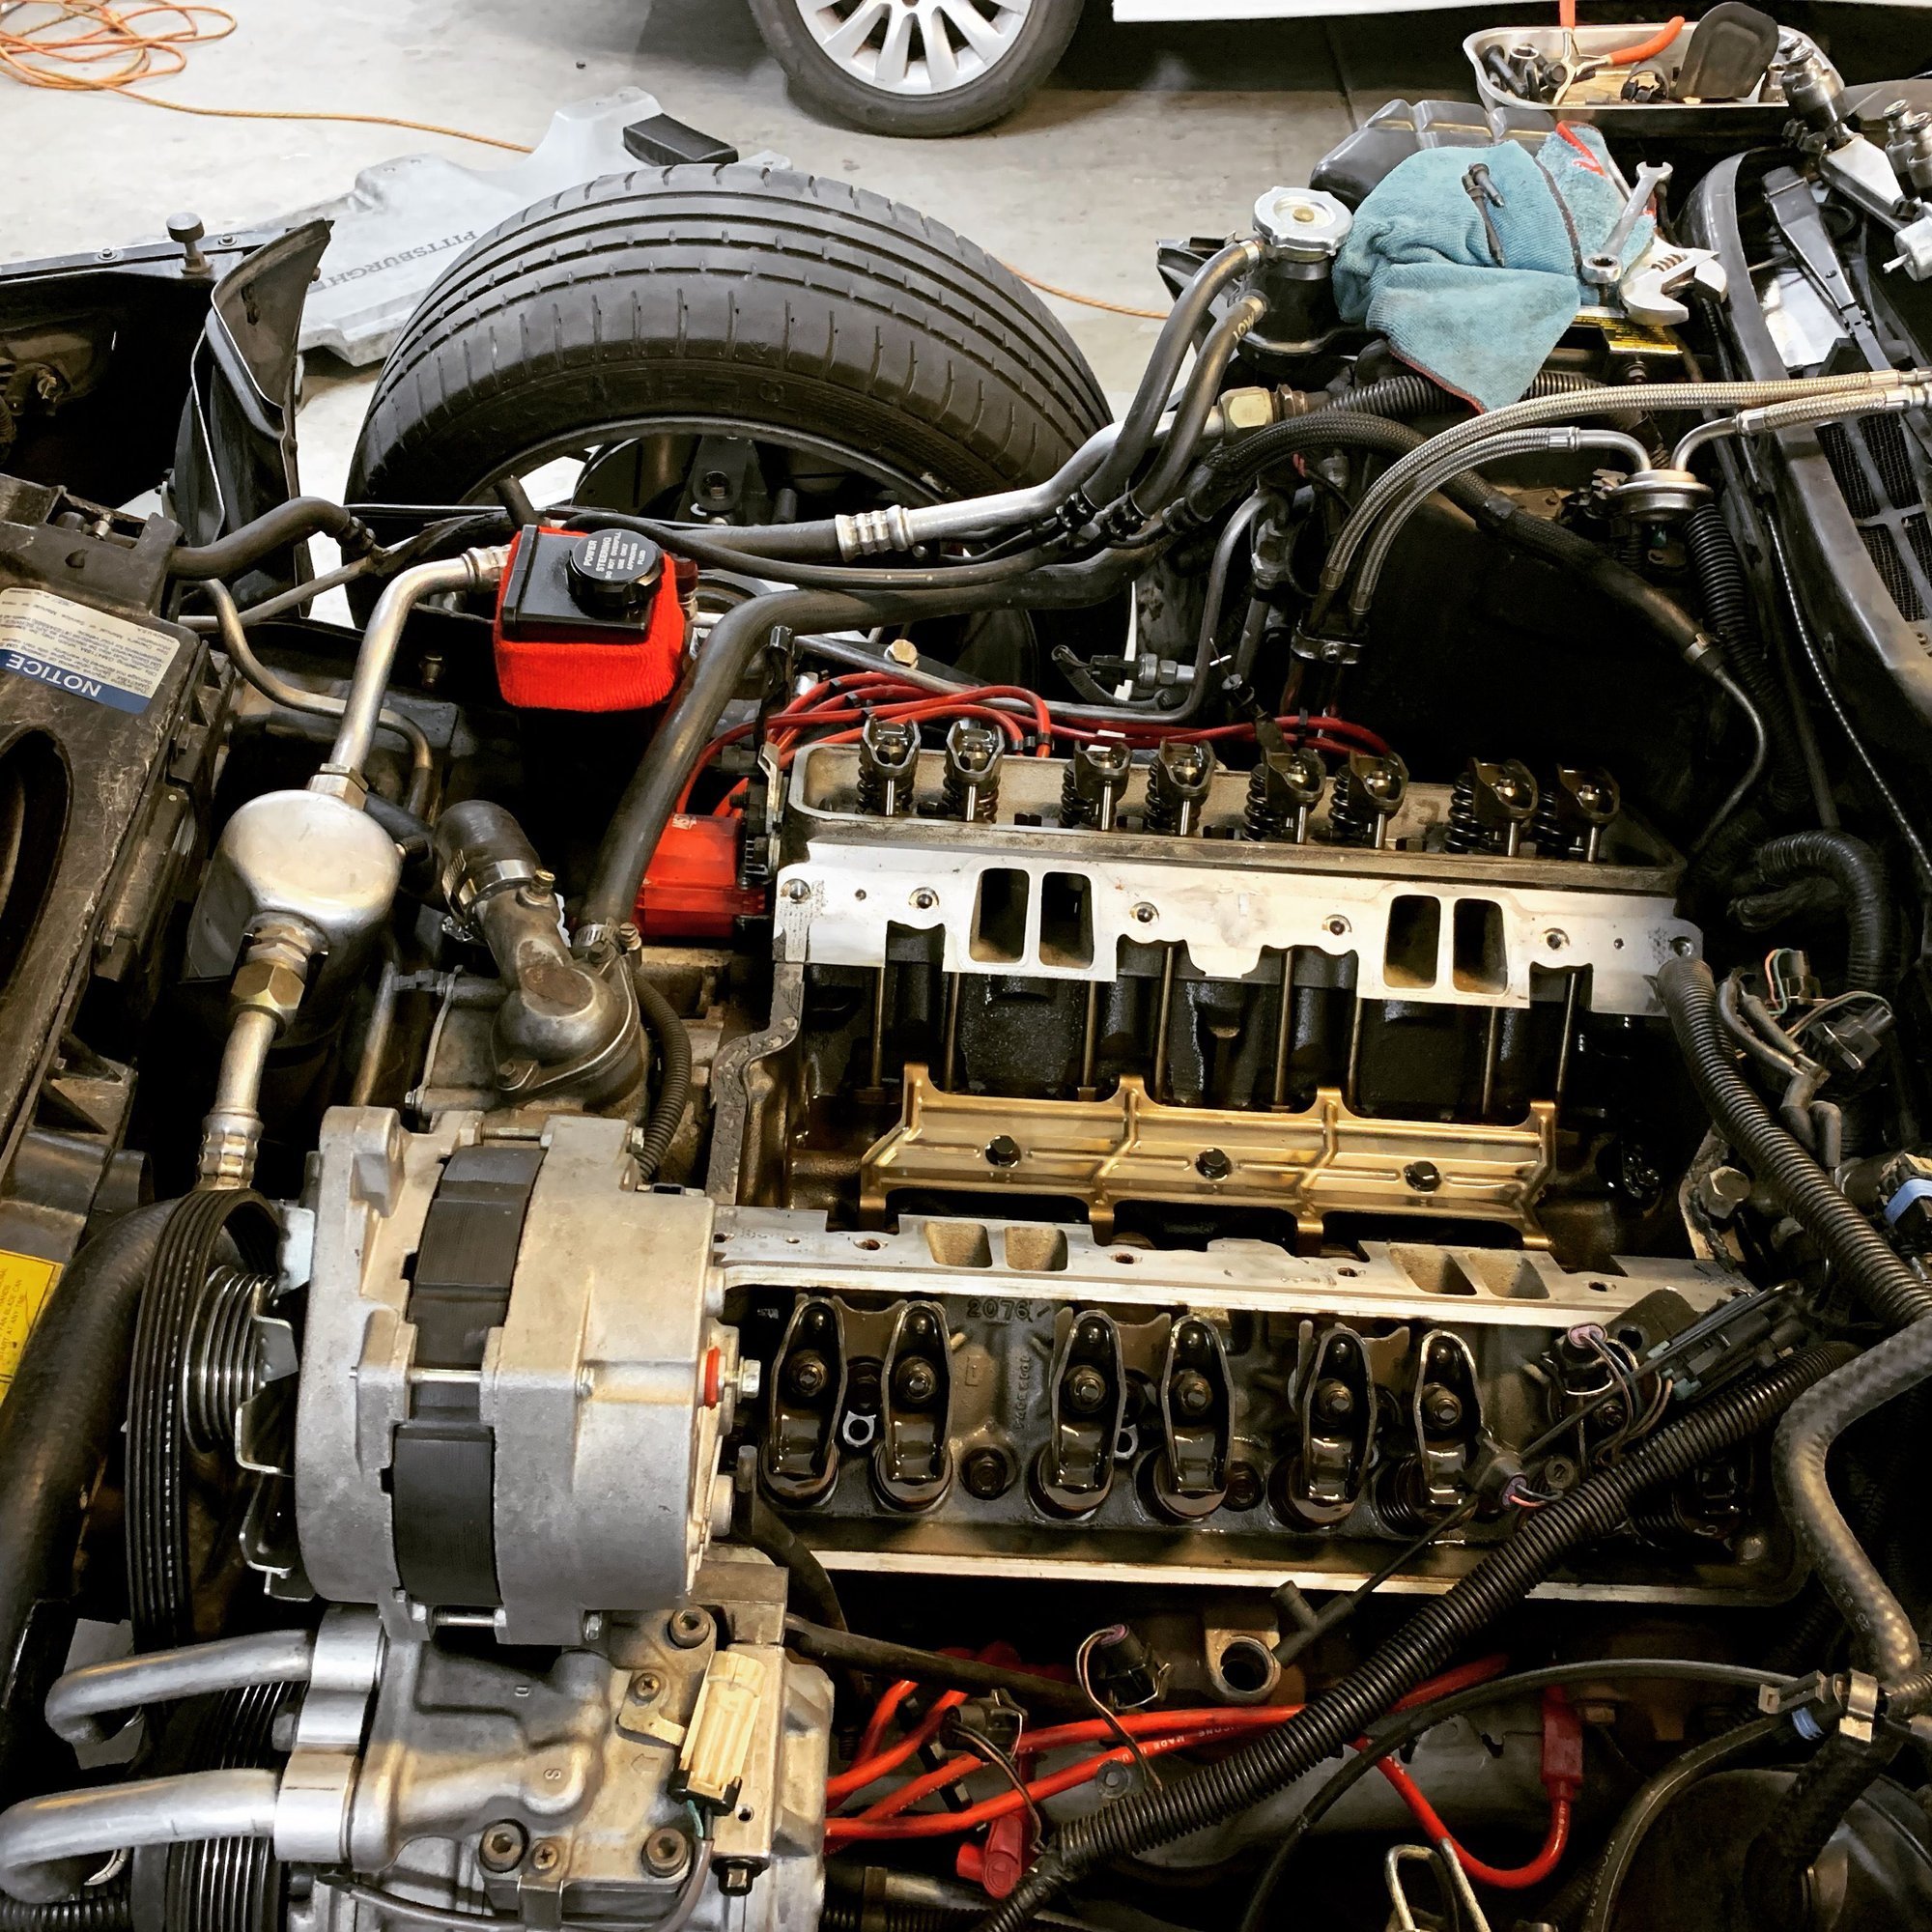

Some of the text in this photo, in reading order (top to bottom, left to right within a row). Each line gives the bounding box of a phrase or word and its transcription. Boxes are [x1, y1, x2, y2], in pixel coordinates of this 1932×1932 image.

[327, 230, 478, 287] PITTSBURGH
[583, 540, 597, 566] POWER
[596, 537, 611, 572] STEERING
[5, 653, 102, 697] NOTICE
[1152, 1734, 1185, 1750] MADE
